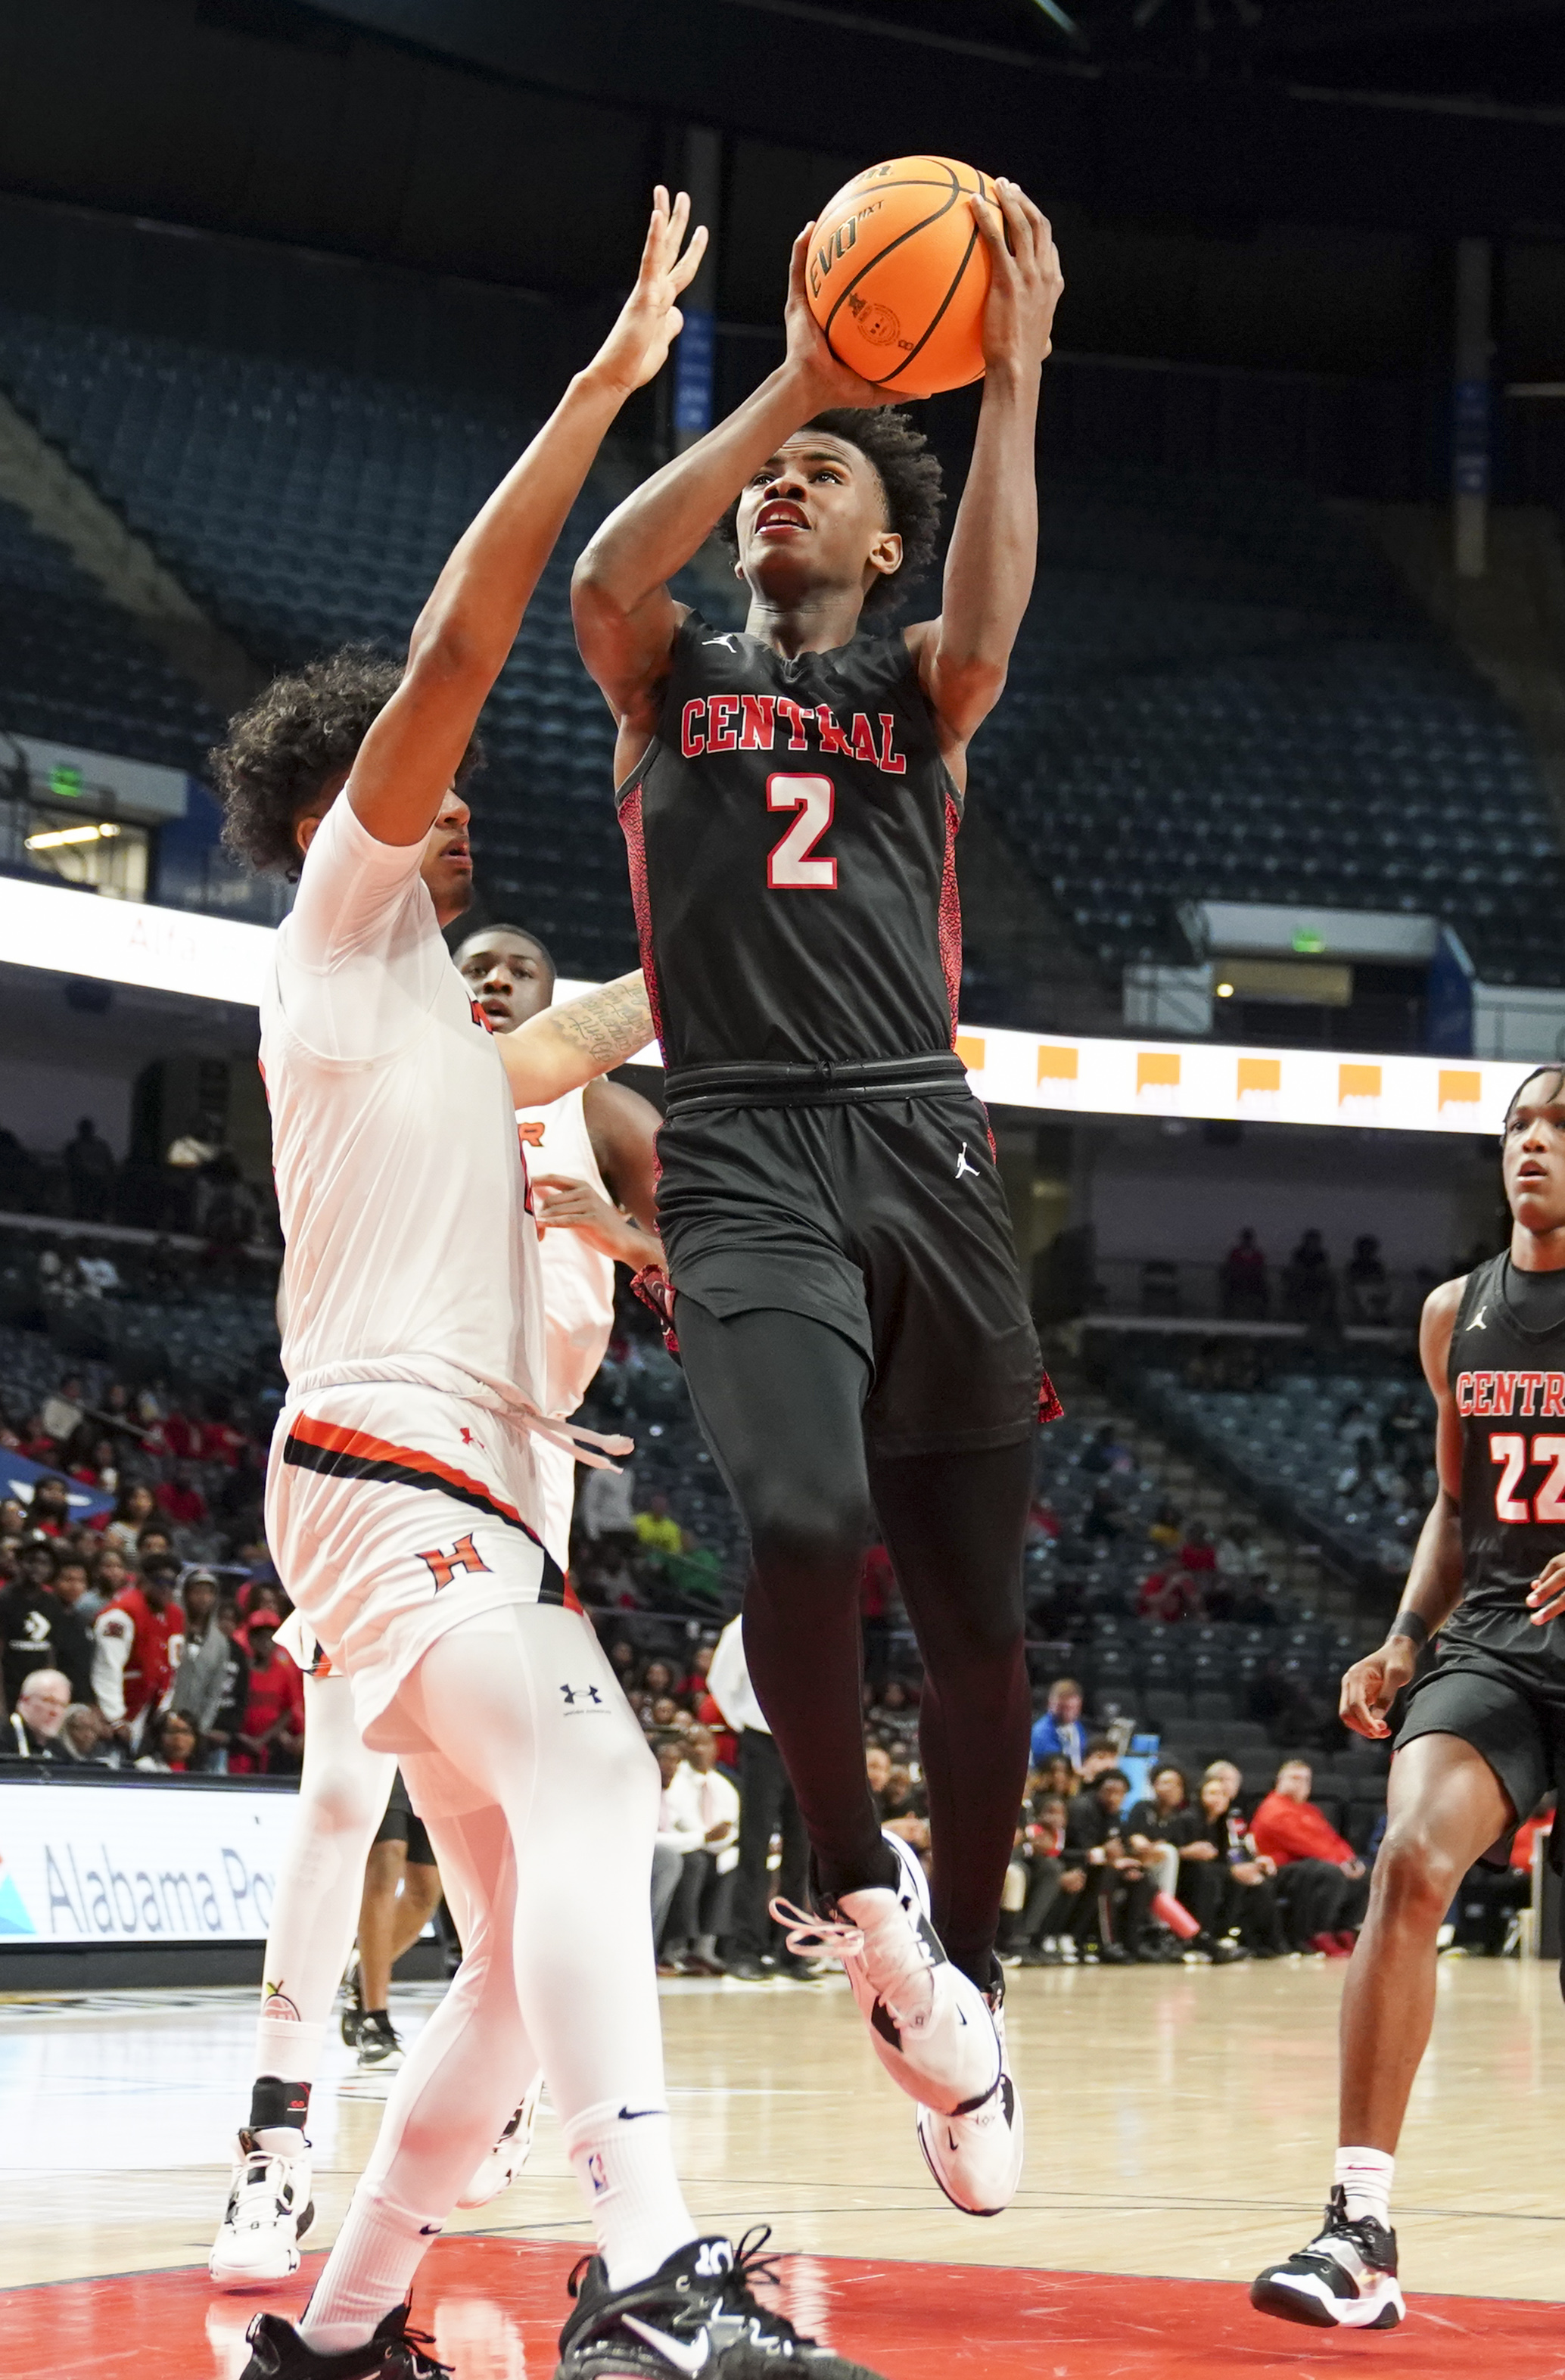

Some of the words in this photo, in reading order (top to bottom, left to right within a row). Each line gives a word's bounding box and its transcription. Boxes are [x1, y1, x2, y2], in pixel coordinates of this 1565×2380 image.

[810, 215, 857, 300] EVO
[682, 695, 907, 774] CENTRAL
[767, 772, 838, 889] 2
[1489, 1432, 1565, 1524] 22
[414, 1532, 494, 1598] H
[45, 1843, 225, 1934] Alabama
